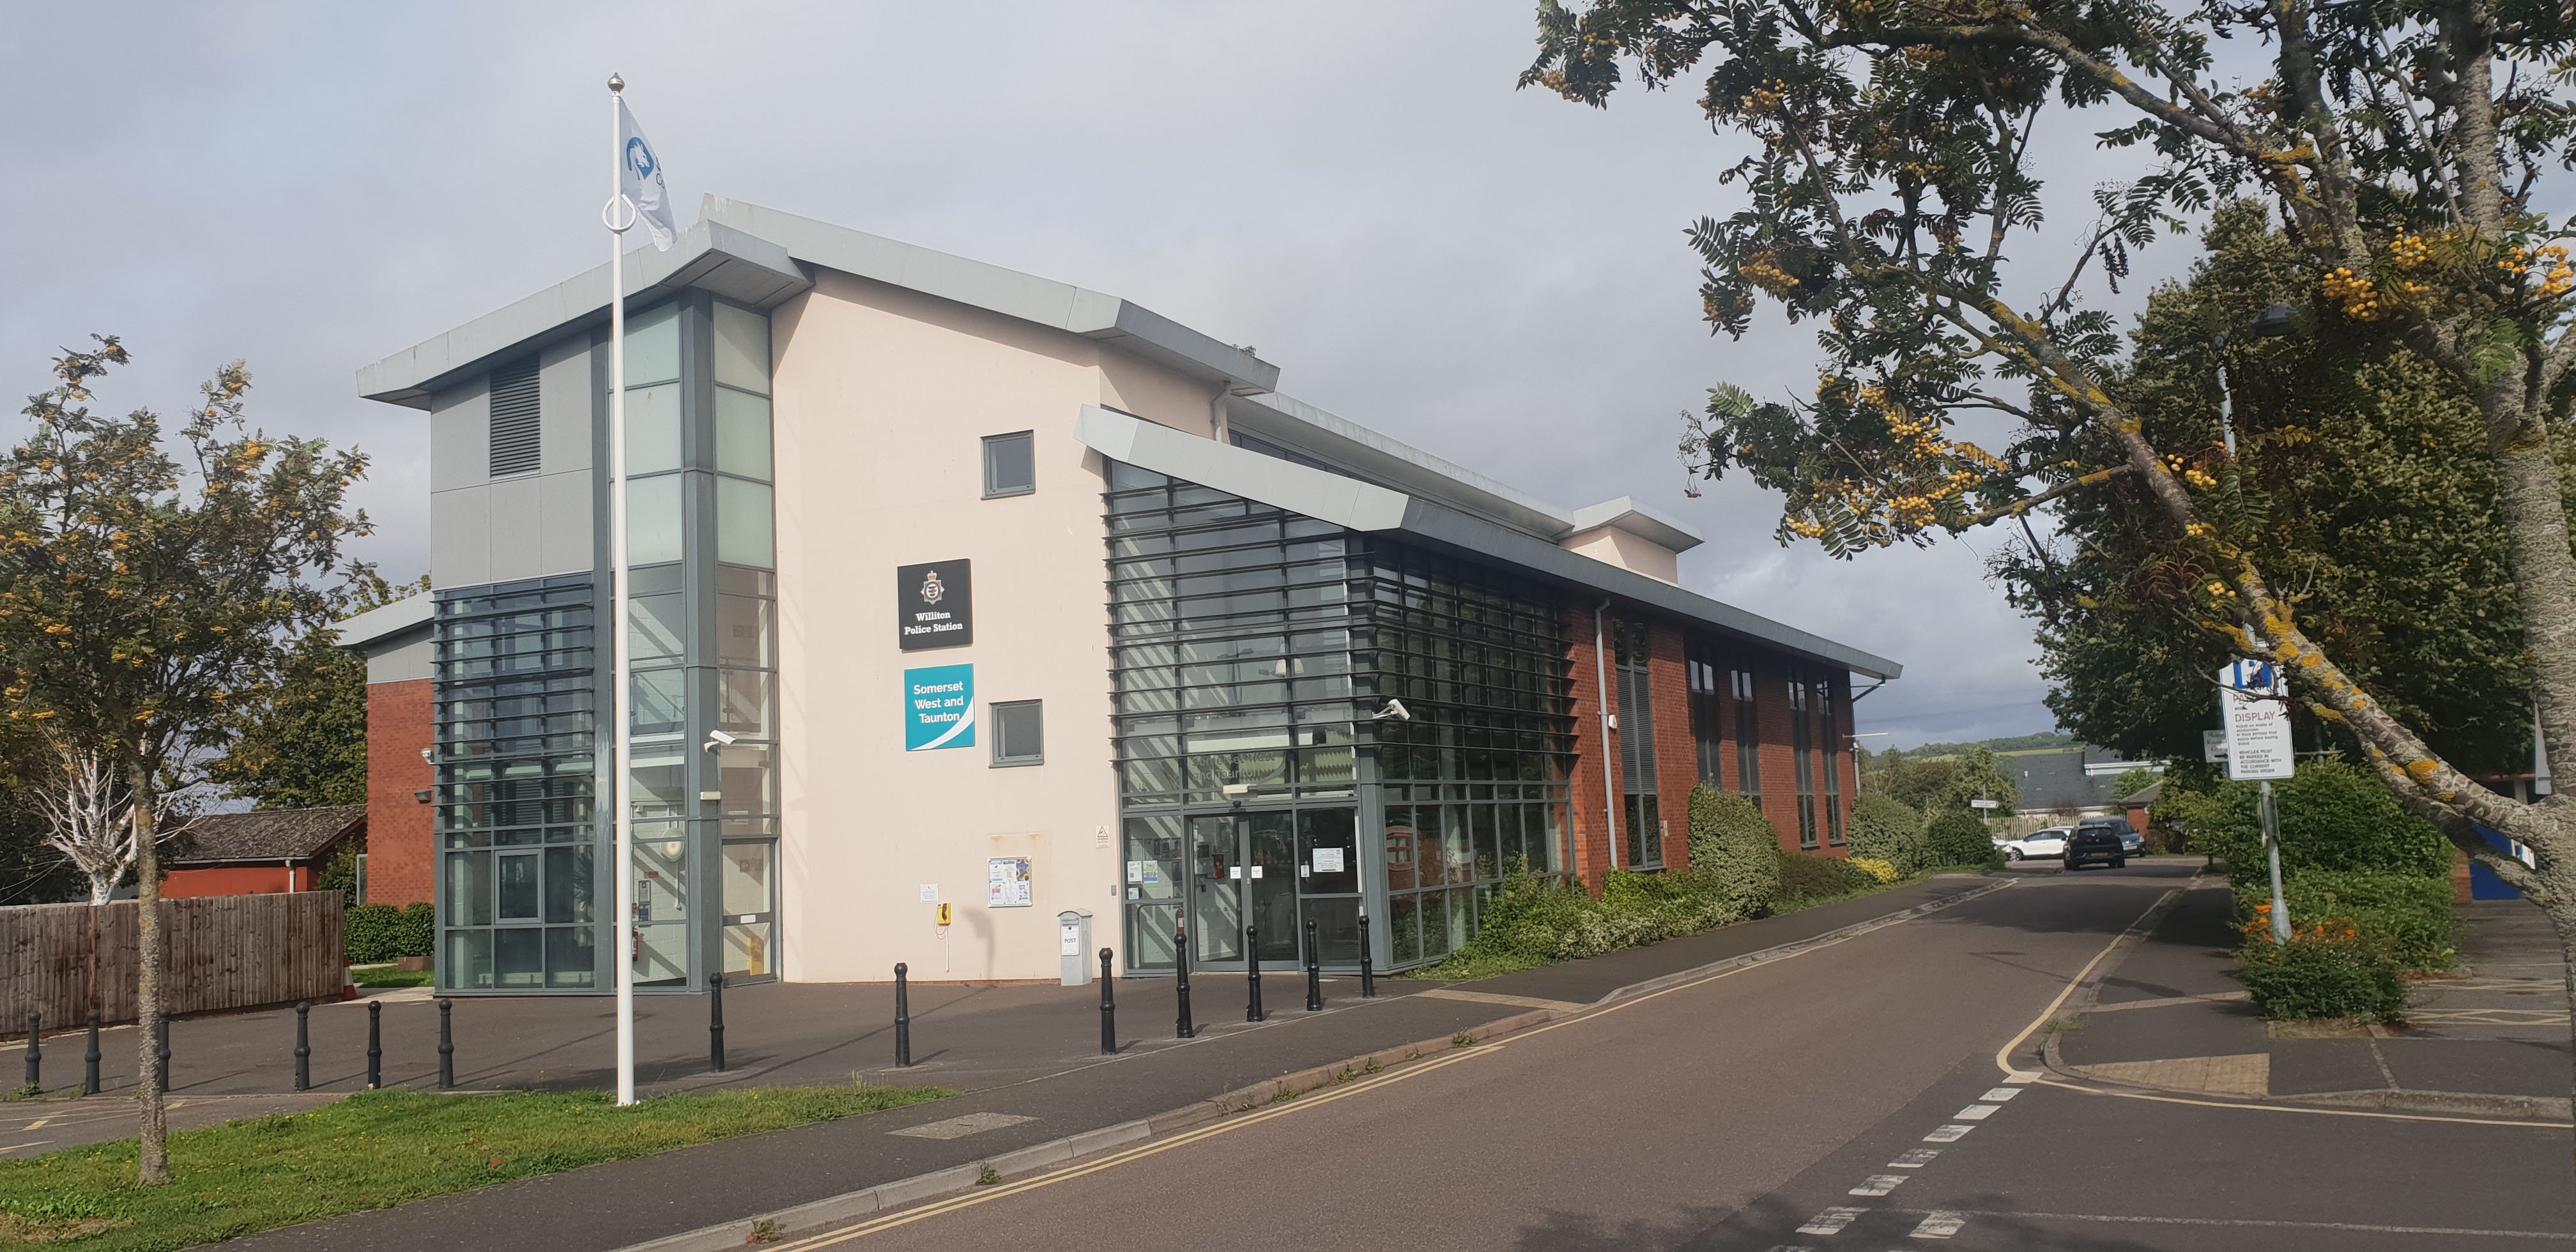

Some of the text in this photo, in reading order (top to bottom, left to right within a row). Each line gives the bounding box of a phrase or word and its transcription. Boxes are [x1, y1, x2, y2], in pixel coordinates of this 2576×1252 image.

[916, 611, 951, 622] Williton
[904, 622, 963, 635] Police Station
[914, 680, 963, 695] Somerset
[914, 695, 963, 709] West and
[919, 712, 960, 723] Taunton
[2235, 711, 2275, 722] DISPLAY
[1216, 767, 1261, 779] Taunton
